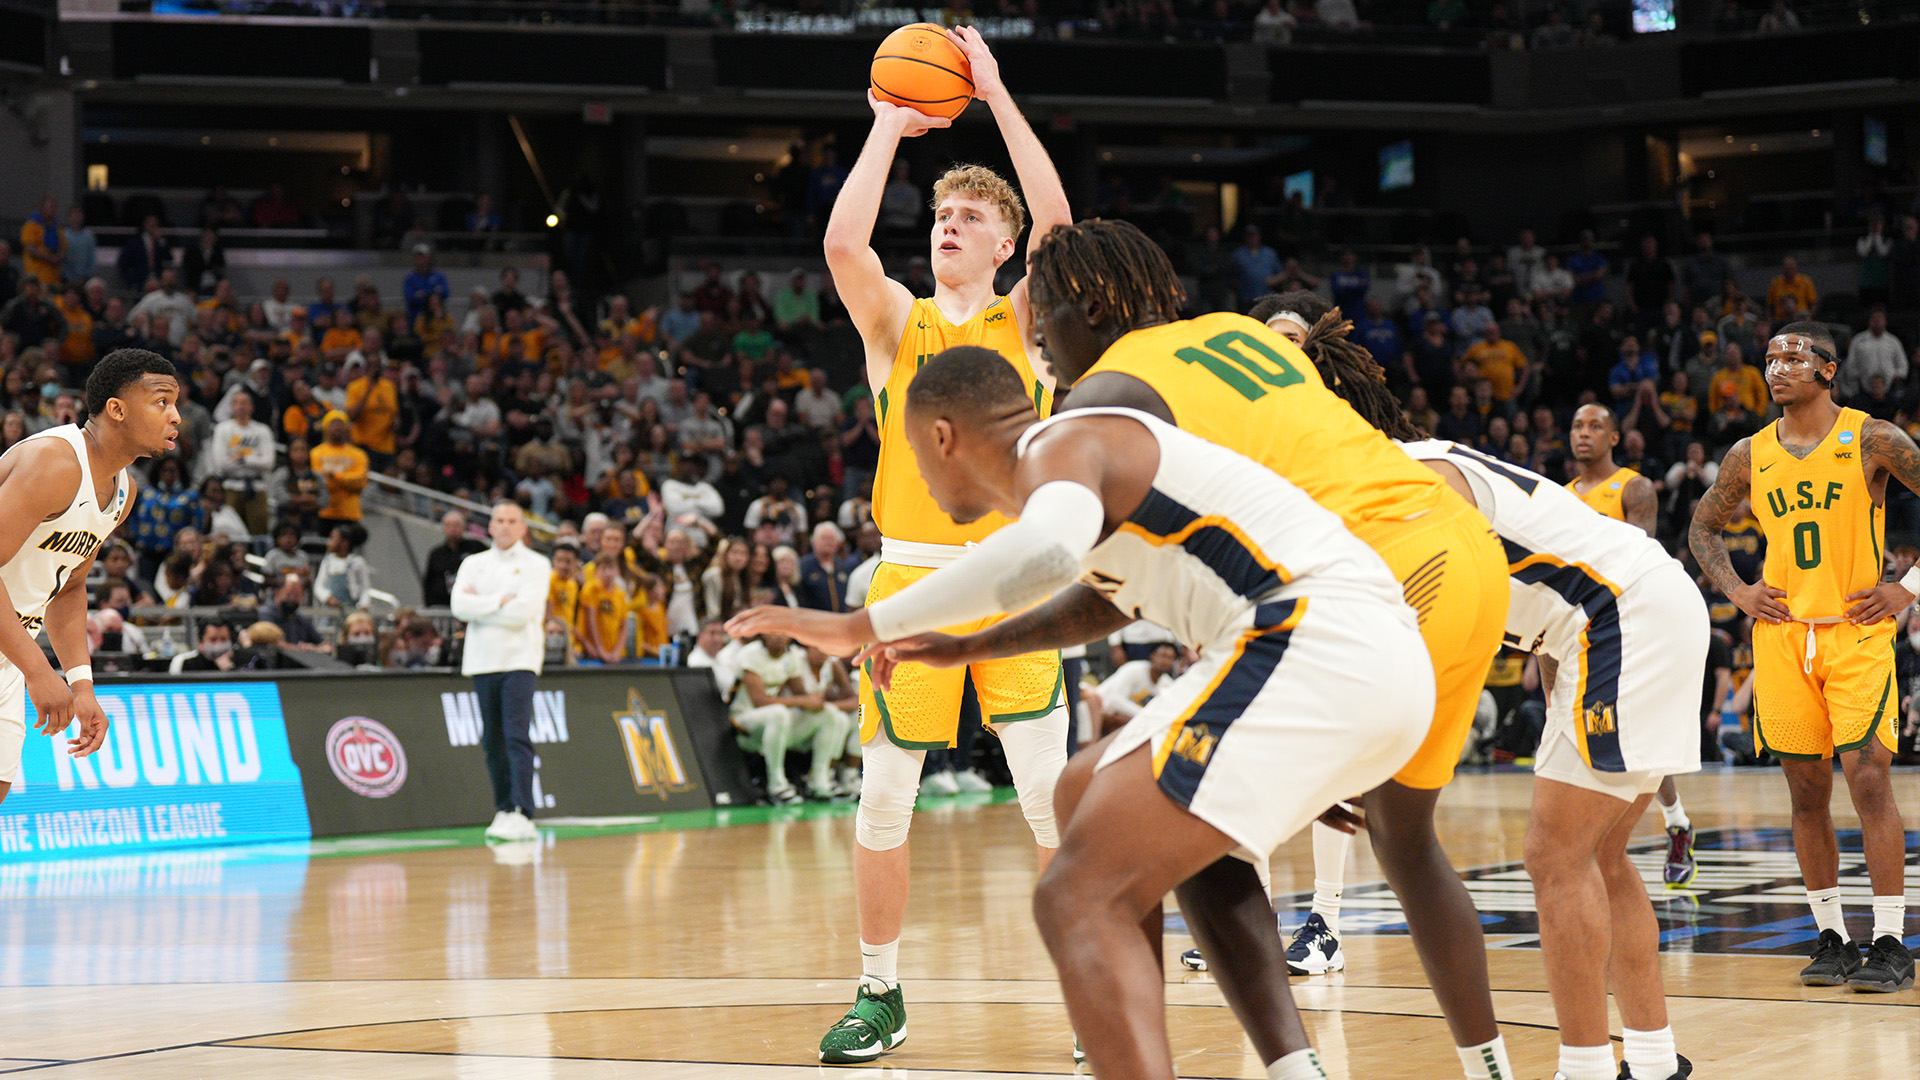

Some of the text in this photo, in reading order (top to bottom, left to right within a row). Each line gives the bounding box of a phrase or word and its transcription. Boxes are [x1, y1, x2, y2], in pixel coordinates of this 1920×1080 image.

[1173, 330, 1305, 402] 10
[1766, 480, 1843, 518] U.S.F
[1793, 521, 1821, 570] 0
[50, 692, 262, 791] ROUND
[441, 690, 569, 747] MAY
[343, 742, 389, 774] OVC
[35, 806, 141, 850] HORIZON
[143, 802, 227, 842] LEAGUE
